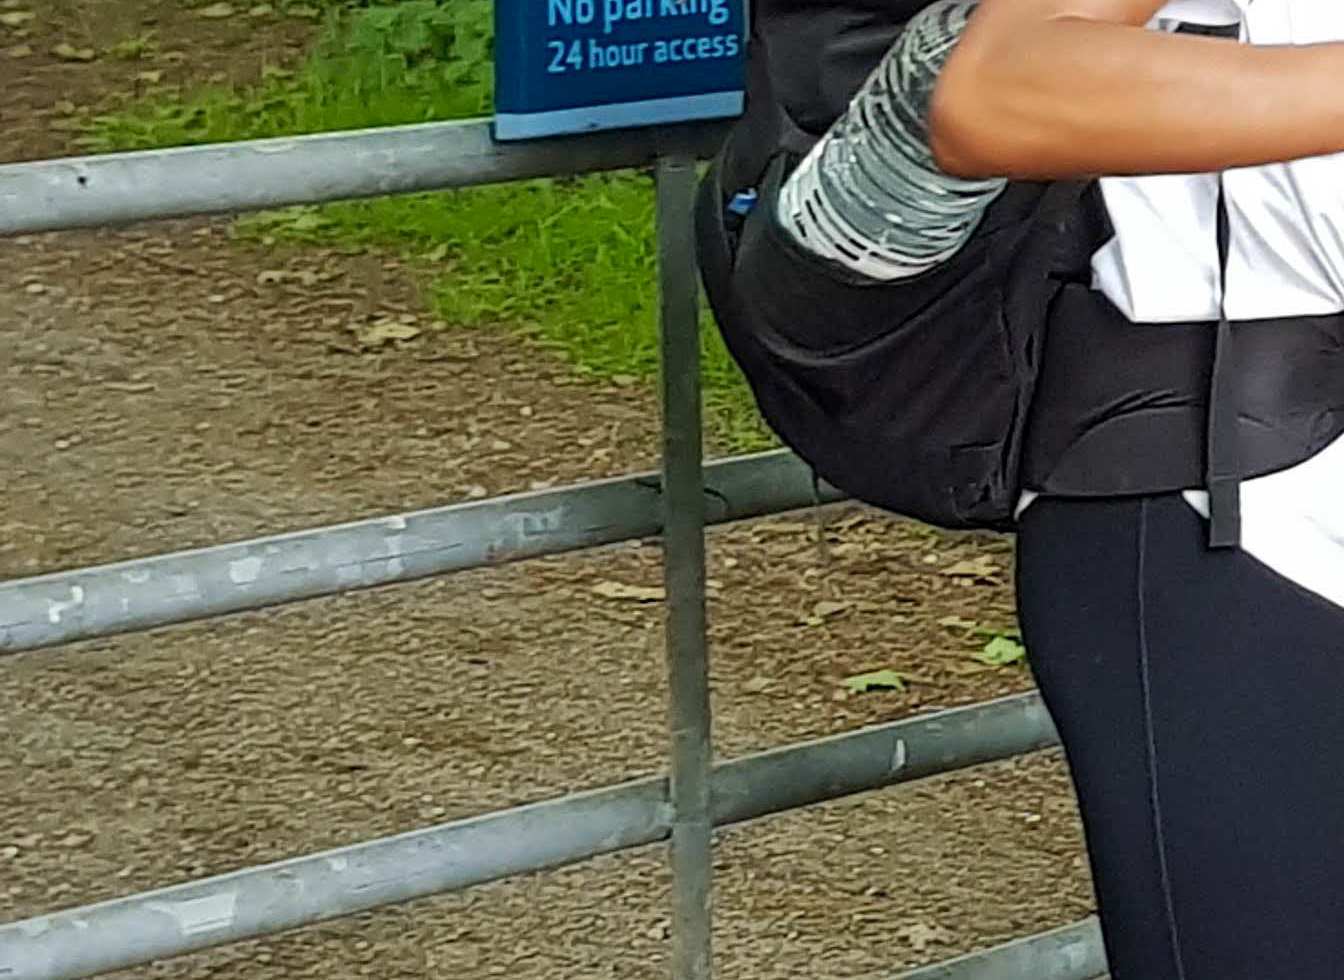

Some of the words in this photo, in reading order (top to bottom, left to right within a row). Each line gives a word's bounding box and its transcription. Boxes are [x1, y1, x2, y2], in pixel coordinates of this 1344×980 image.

[547, 39, 582, 73] 24
[589, 38, 648, 69] hour
[654, 34, 739, 64] access
